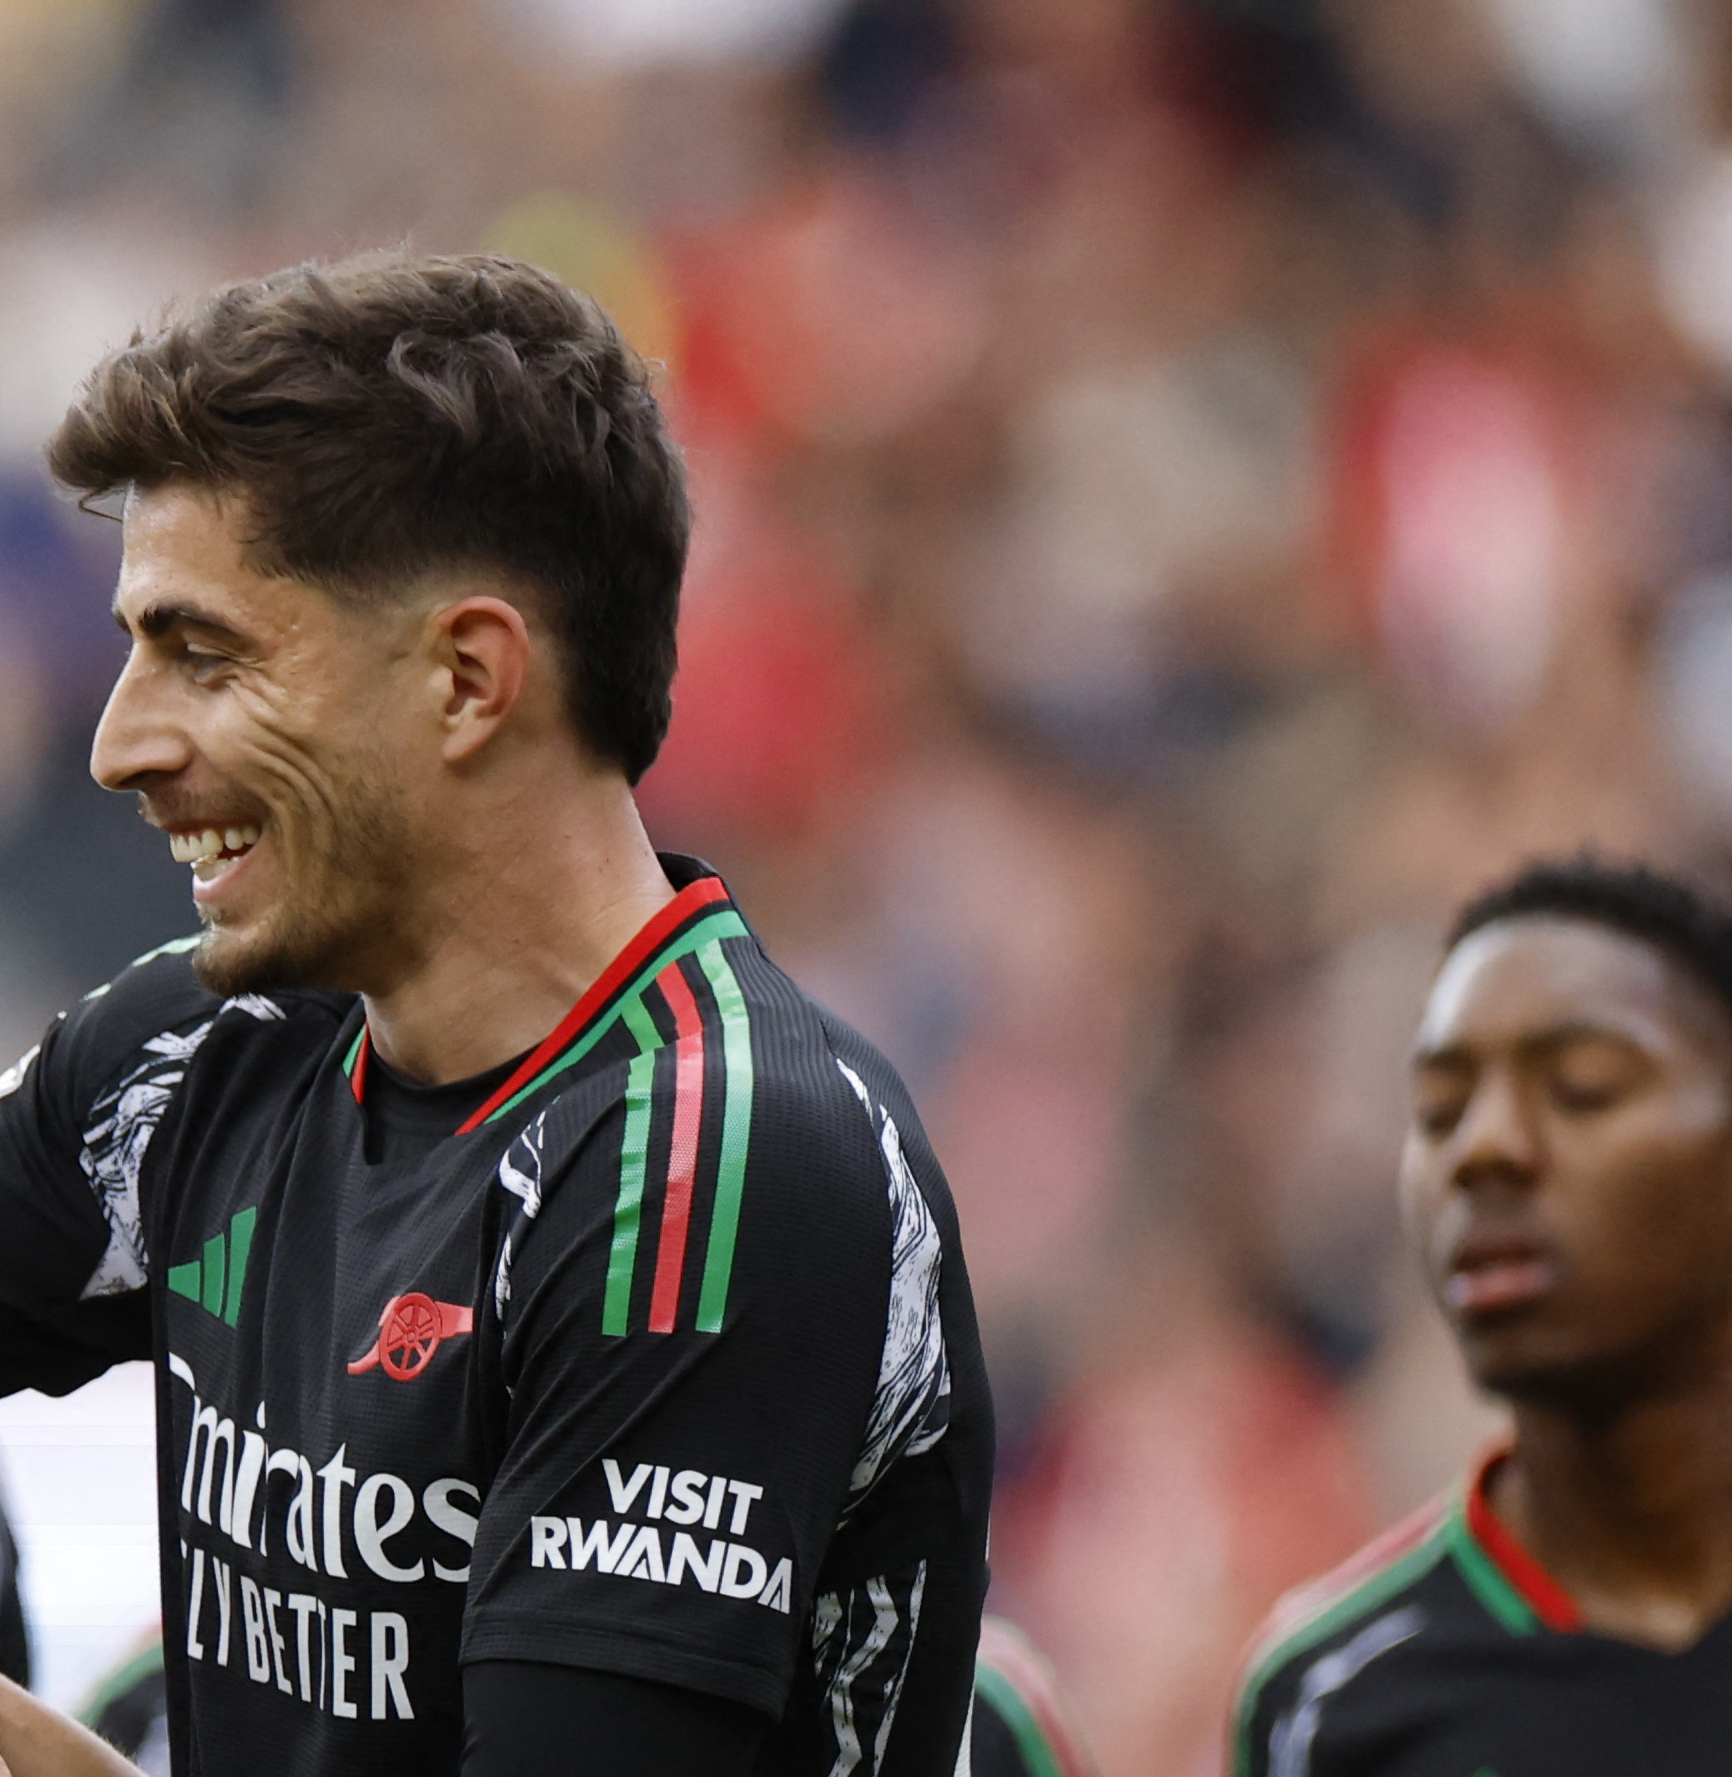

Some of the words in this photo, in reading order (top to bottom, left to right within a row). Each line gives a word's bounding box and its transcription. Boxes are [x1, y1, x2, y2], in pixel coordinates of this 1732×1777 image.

[169, 1352, 483, 1584] mirates
[601, 1459, 764, 1536] VISIT
[180, 1537, 231, 1668] LY
[531, 1516, 793, 1614] RWANDA
